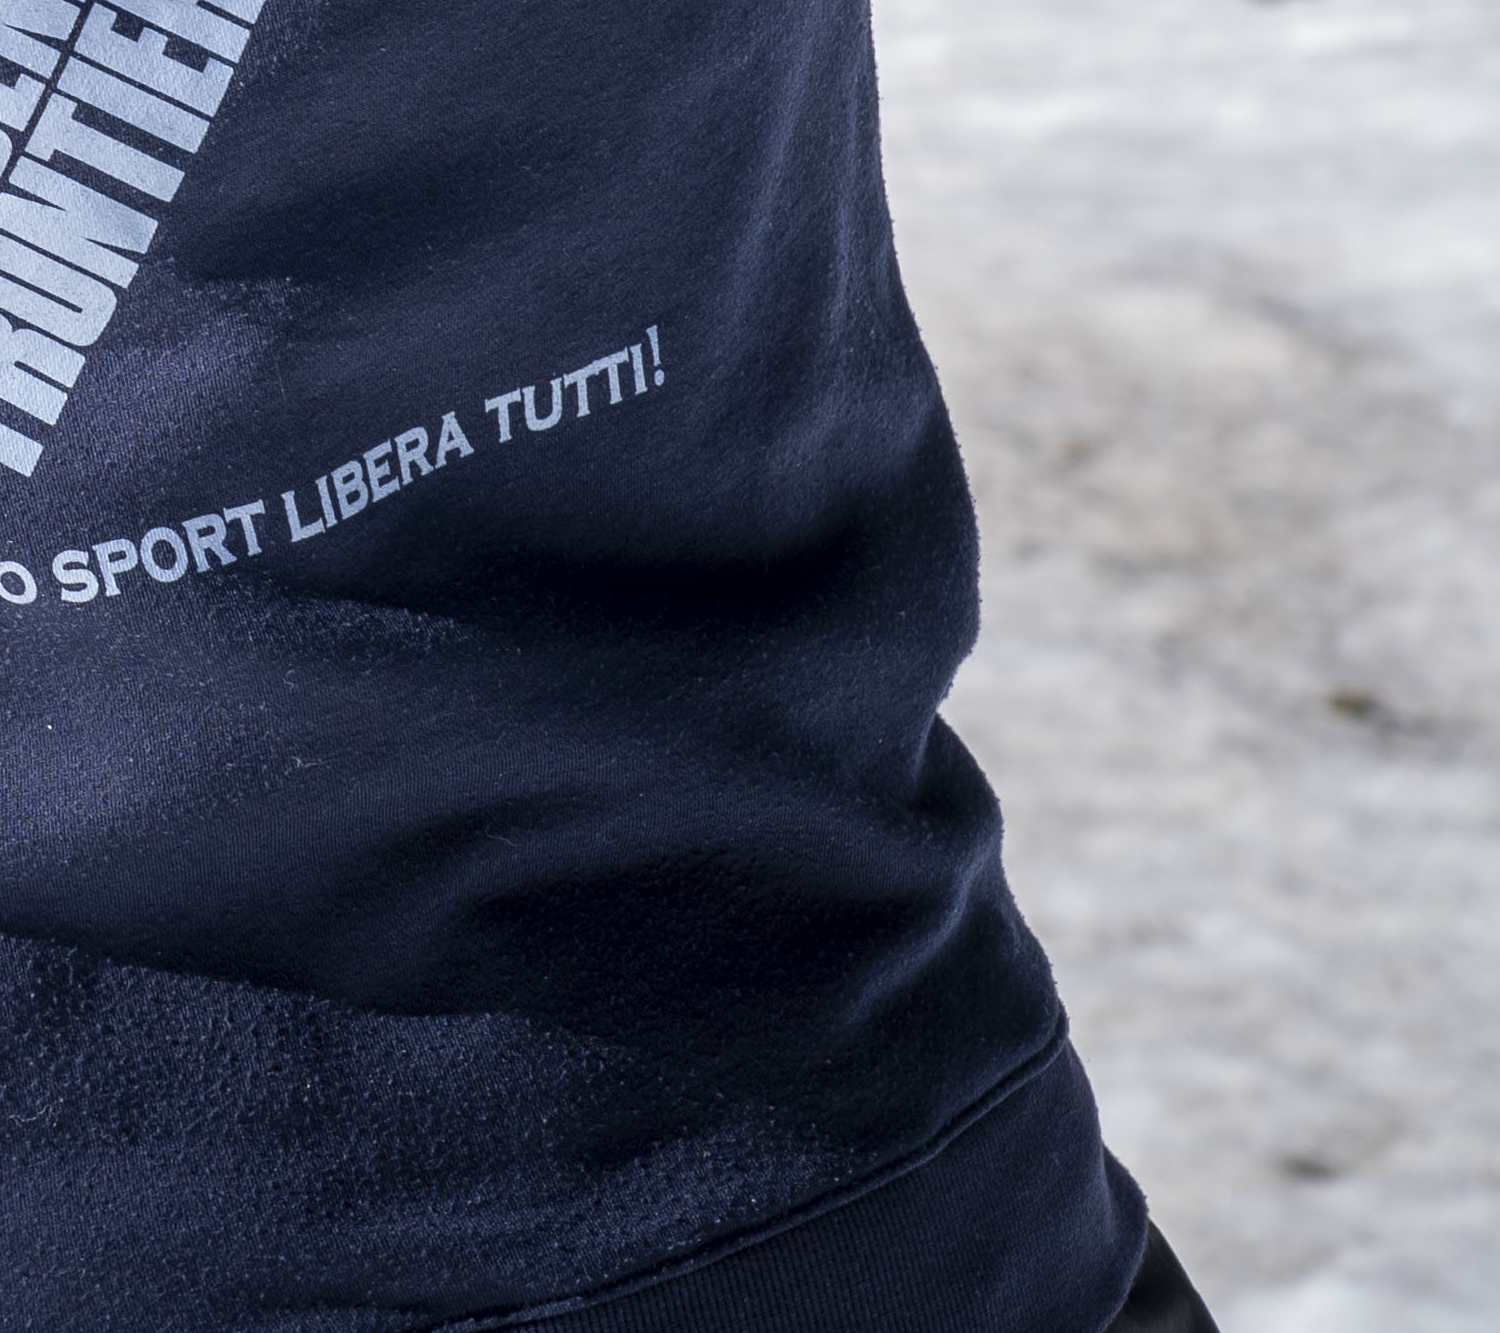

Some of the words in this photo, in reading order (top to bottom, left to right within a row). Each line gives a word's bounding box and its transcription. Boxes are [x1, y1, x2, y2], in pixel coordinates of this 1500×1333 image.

[51, 499, 266, 605] SPORT
[280, 411, 476, 543] LIBERA
[483, 324, 667, 444] TUTTI!
